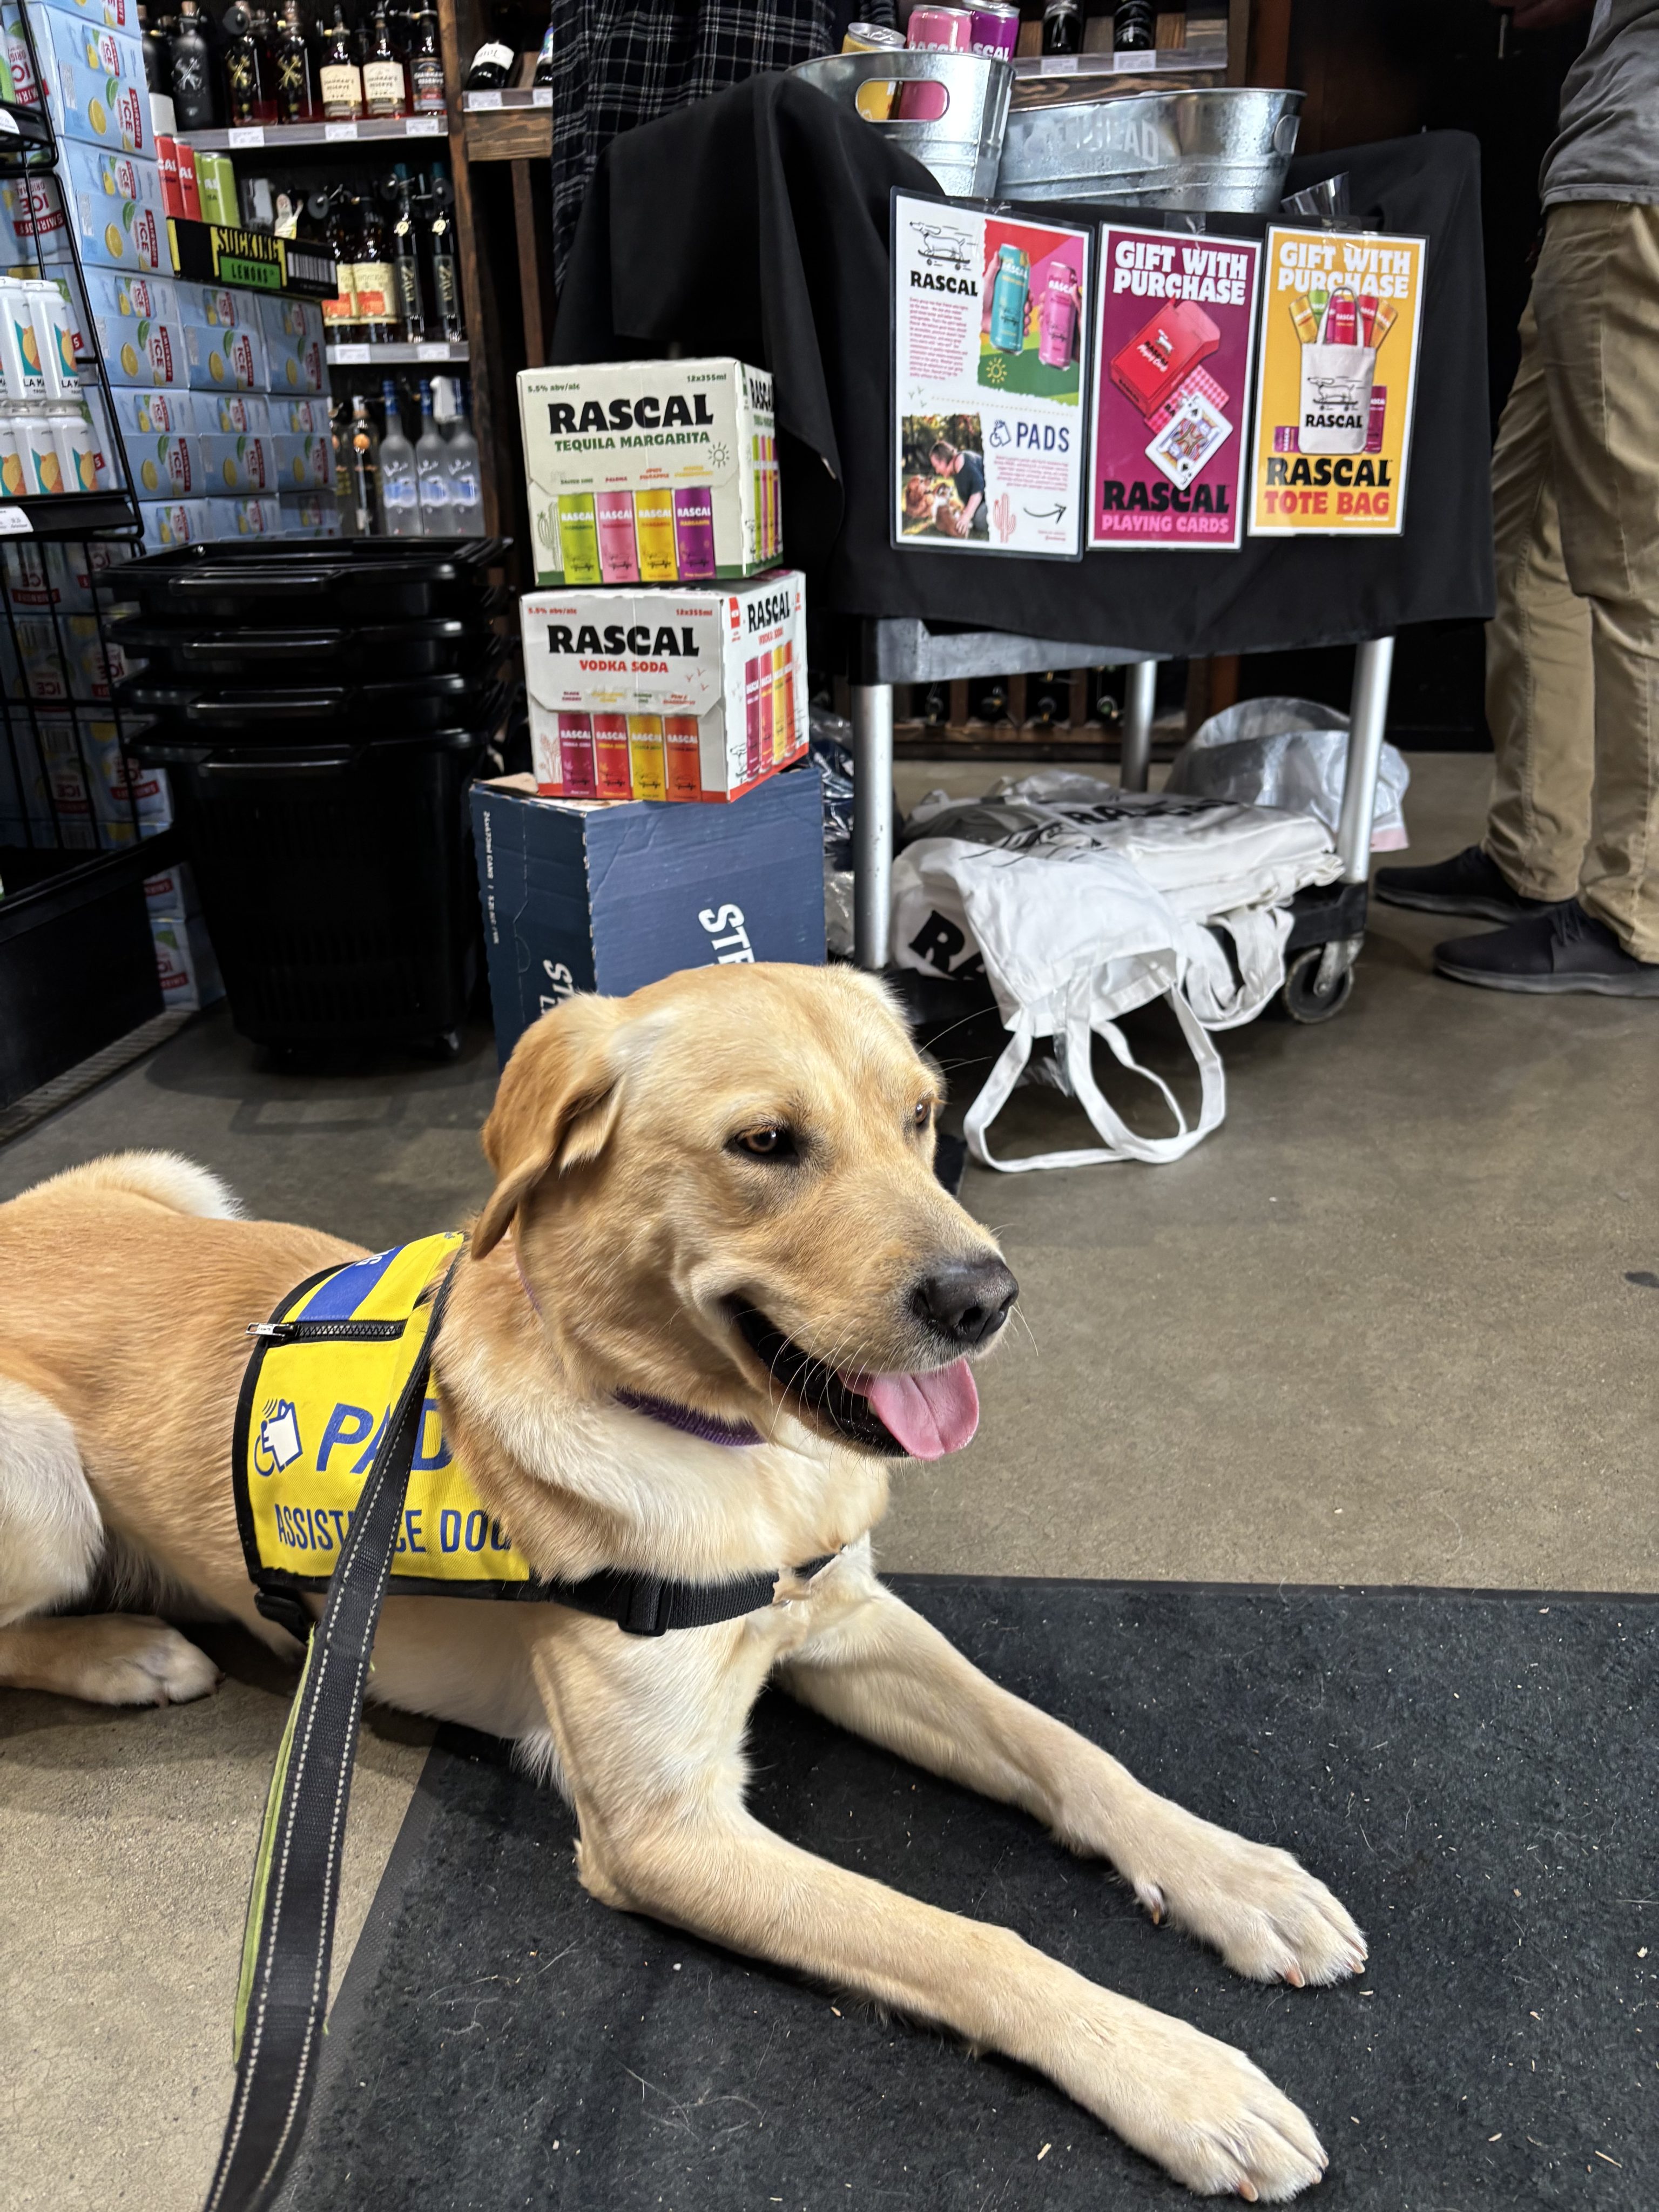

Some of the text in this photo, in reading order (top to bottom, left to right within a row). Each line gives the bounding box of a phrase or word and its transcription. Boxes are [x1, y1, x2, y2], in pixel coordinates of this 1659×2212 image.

[123, 100, 133, 132] ICE
[19, 193, 49, 214] ICE
[139, 222, 149, 252] ICE
[1115, 240, 1248, 280] GIFT WITH
[1279, 241, 1411, 275] GIFT WITH
[231, 264, 268, 284] LEMONS
[910, 271, 978, 296] RASCAL
[1112, 267, 1246, 306] PURCHASE
[1277, 267, 1410, 299] PURCHASE
[154, 339, 164, 369] ICE
[687, 374, 727, 382] 12x355ml
[548, 394, 713, 435] RASCAL
[1305, 414, 1363, 429] RASCAL
[555, 431, 710, 453] TEQUILA MARGARITA
[1016, 422, 1069, 453] PADS
[173, 451, 183, 478] ICE
[1265, 457, 1391, 487] RASCAL
[1103, 480, 1230, 513] RASCAL
[1264, 490, 1389, 516] TOTE BAG
[1101, 515, 1229, 535] PLAYING CARDS
[747, 591, 790, 634] RASCAL
[547, 624, 699, 657] RASCAL
[579, 659, 669, 673] VODKA SODA
